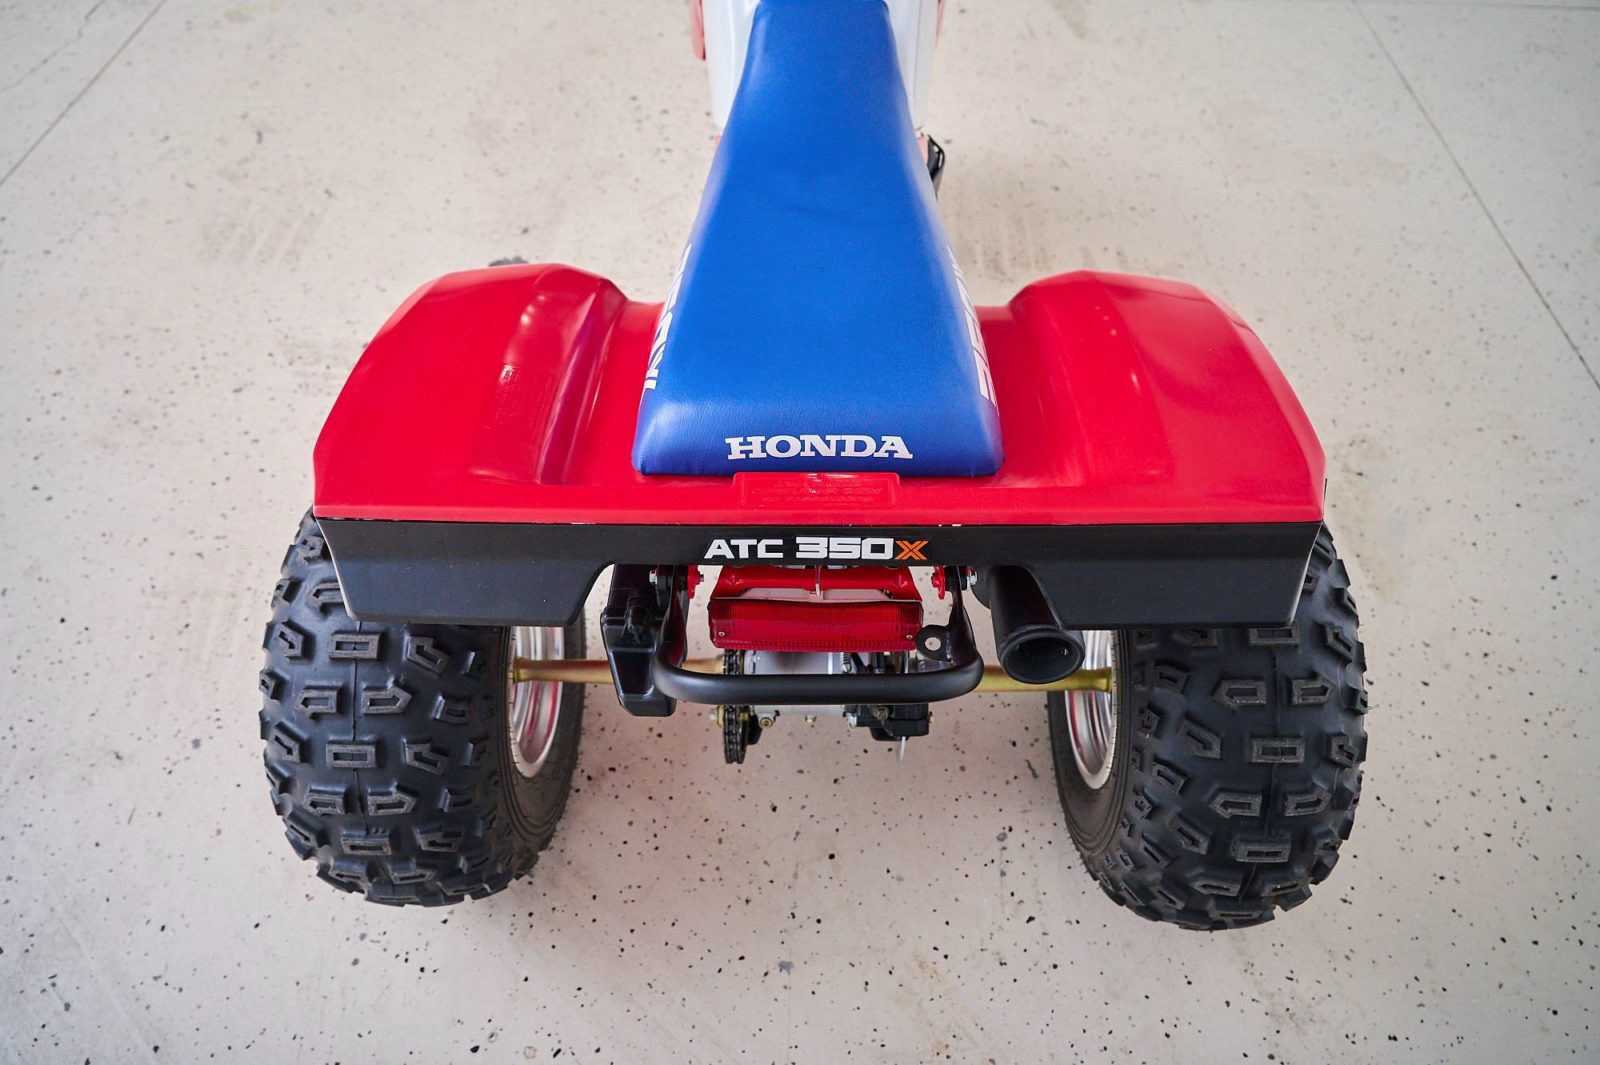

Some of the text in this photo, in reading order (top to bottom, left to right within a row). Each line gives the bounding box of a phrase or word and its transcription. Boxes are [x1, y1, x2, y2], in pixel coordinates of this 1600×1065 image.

[725, 434, 913, 460] HONDA
[704, 536, 929, 561] ATC 350X
